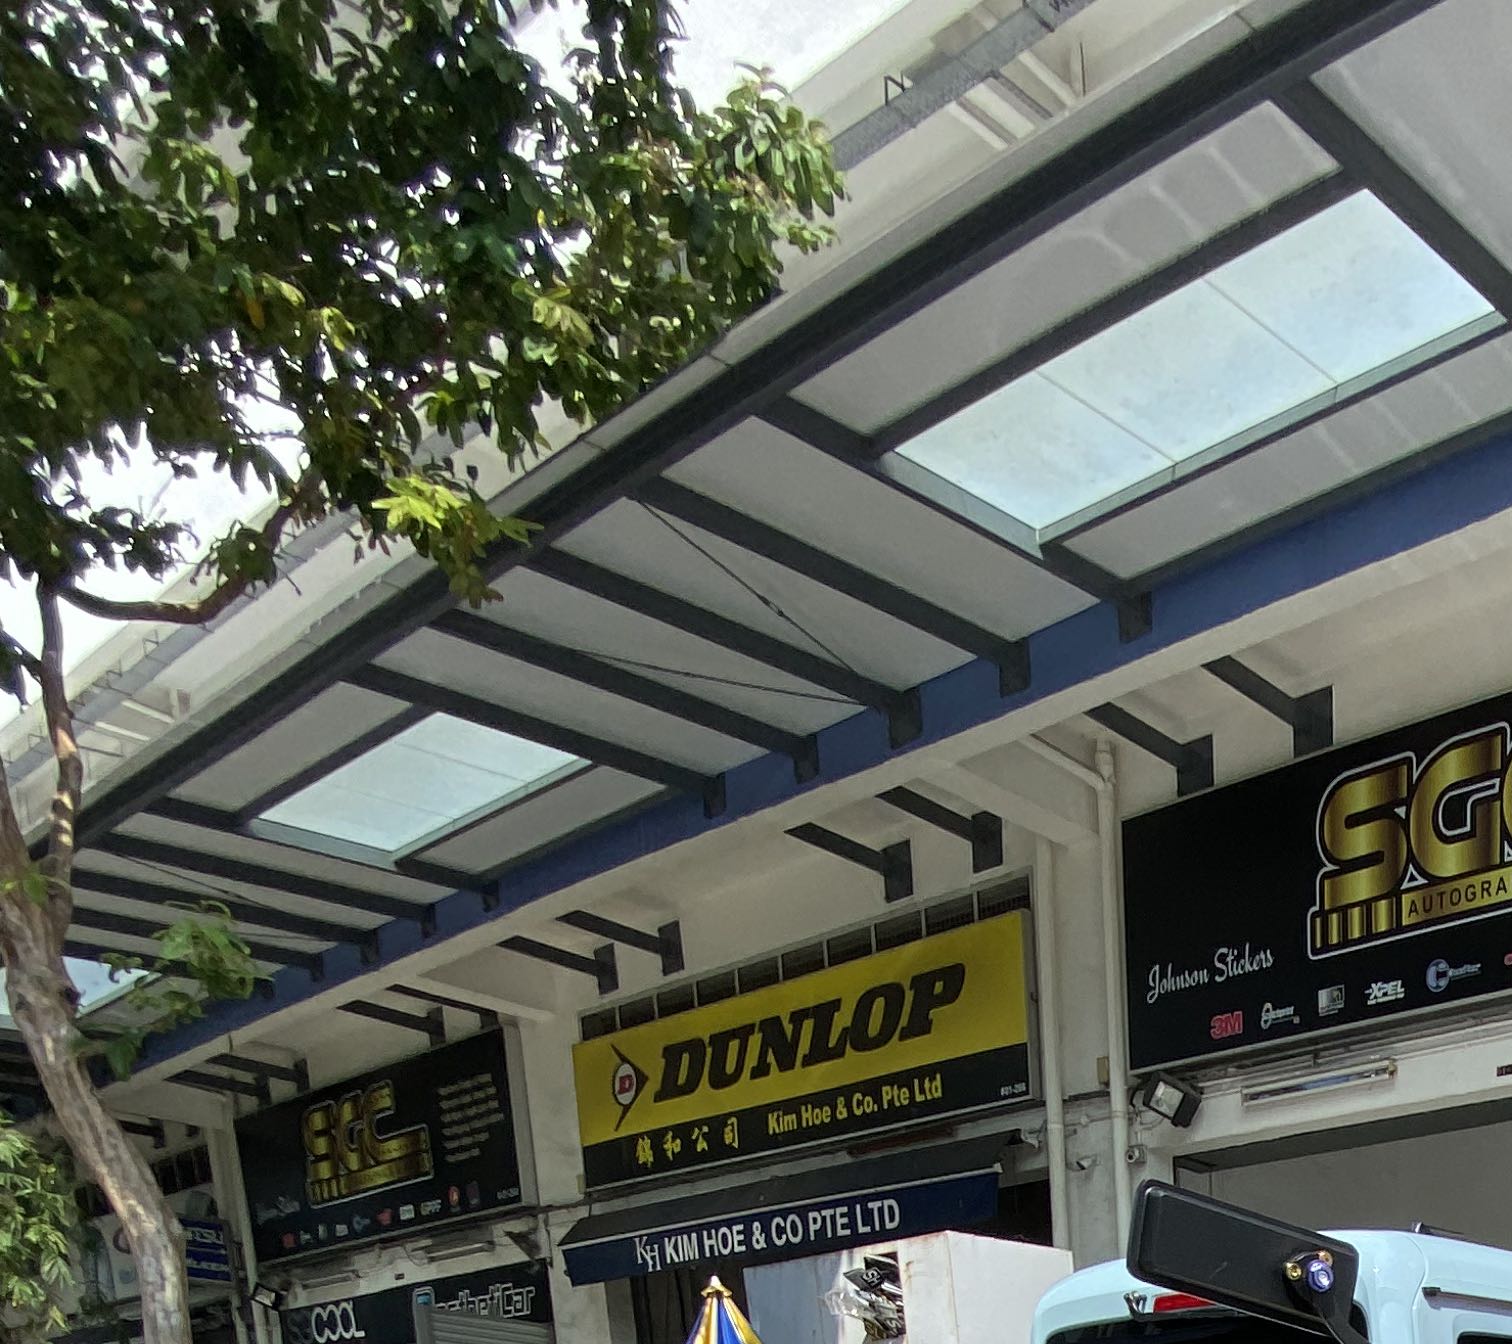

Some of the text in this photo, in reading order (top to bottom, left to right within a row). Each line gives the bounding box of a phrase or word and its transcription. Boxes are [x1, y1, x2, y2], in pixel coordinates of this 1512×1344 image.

[1147, 942, 1275, 1004] Johnson Stickers
[653, 963, 965, 1103] DUNLOP
[1210, 1011, 1244, 1040] 3M
[767, 1072, 943, 1136] Kim Hoe & Co. Pte Ltd
[664, 1232, 700, 1265] KIM
[703, 1223, 747, 1258] HOE
[751, 1220, 767, 1250] &
[770, 1213, 803, 1247] CO
[808, 1206, 851, 1242] PTE
[856, 1198, 901, 1235] LTD
